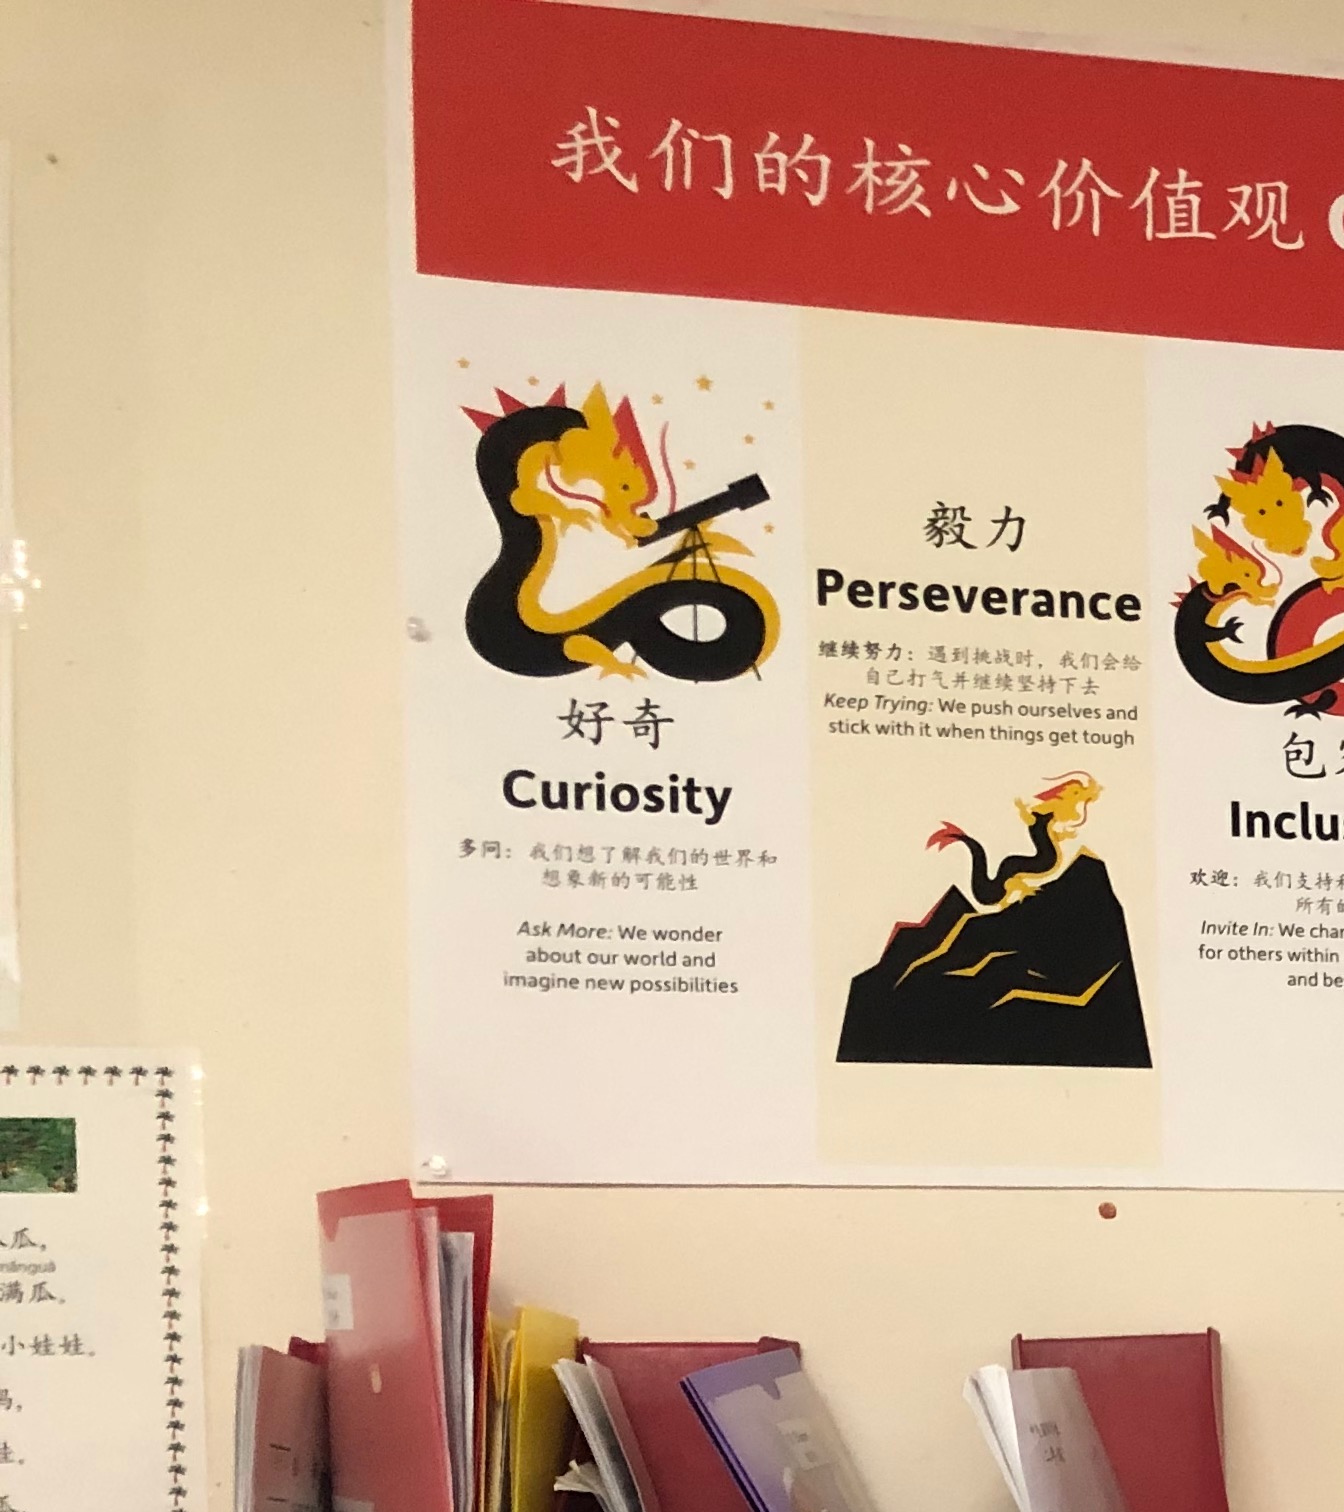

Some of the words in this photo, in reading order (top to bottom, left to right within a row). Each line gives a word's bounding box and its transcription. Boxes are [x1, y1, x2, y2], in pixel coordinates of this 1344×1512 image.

[551, 105, 1303, 252] 我们的核心价值观
[923, 501, 1026, 552] 毅力
[816, 568, 1142, 622] Perseverance
[824, 693, 869, 712] Keep
[874, 695, 933, 716] Trying:
[937, 698, 967, 714] We
[971, 701, 1013, 718] push
[1018, 703, 1101, 720] ourselves
[1106, 706, 1138, 721] and
[556, 698, 674, 750] 好奇
[829, 719, 870, 735] stick
[875, 721, 914, 737] with
[919, 723, 932, 738] it
[936, 724, 985, 740] when
[990, 726, 1044, 744] things
[1049, 729, 1079, 746] get
[1082, 730, 1135, 749] tough
[502, 769, 733, 825] Curiosity
[516, 921, 552, 937] Ask
[556, 923, 612, 940] More:
[618, 925, 648, 941] We
[652, 926, 723, 943] wonder
[1201, 920, 1248, 937] Invite
[1253, 922, 1274, 937] In:
[1278, 923, 1305, 939] We
[525, 947, 581, 964] about
[587, 951, 618, 966] our
[623, 950, 676, 967] world
[682, 952, 716, 967] and
[1198, 943, 1223, 960] for
[1227, 945, 1283, 962] others
[1287, 947, 1339, 963] within
[503, 971, 580, 992] imagine
[584, 977, 625, 991] new
[630, 975, 739, 994] possibilities
[1287, 972, 1318, 987] and
[0, 1227, 46, 1251] 瓜，
